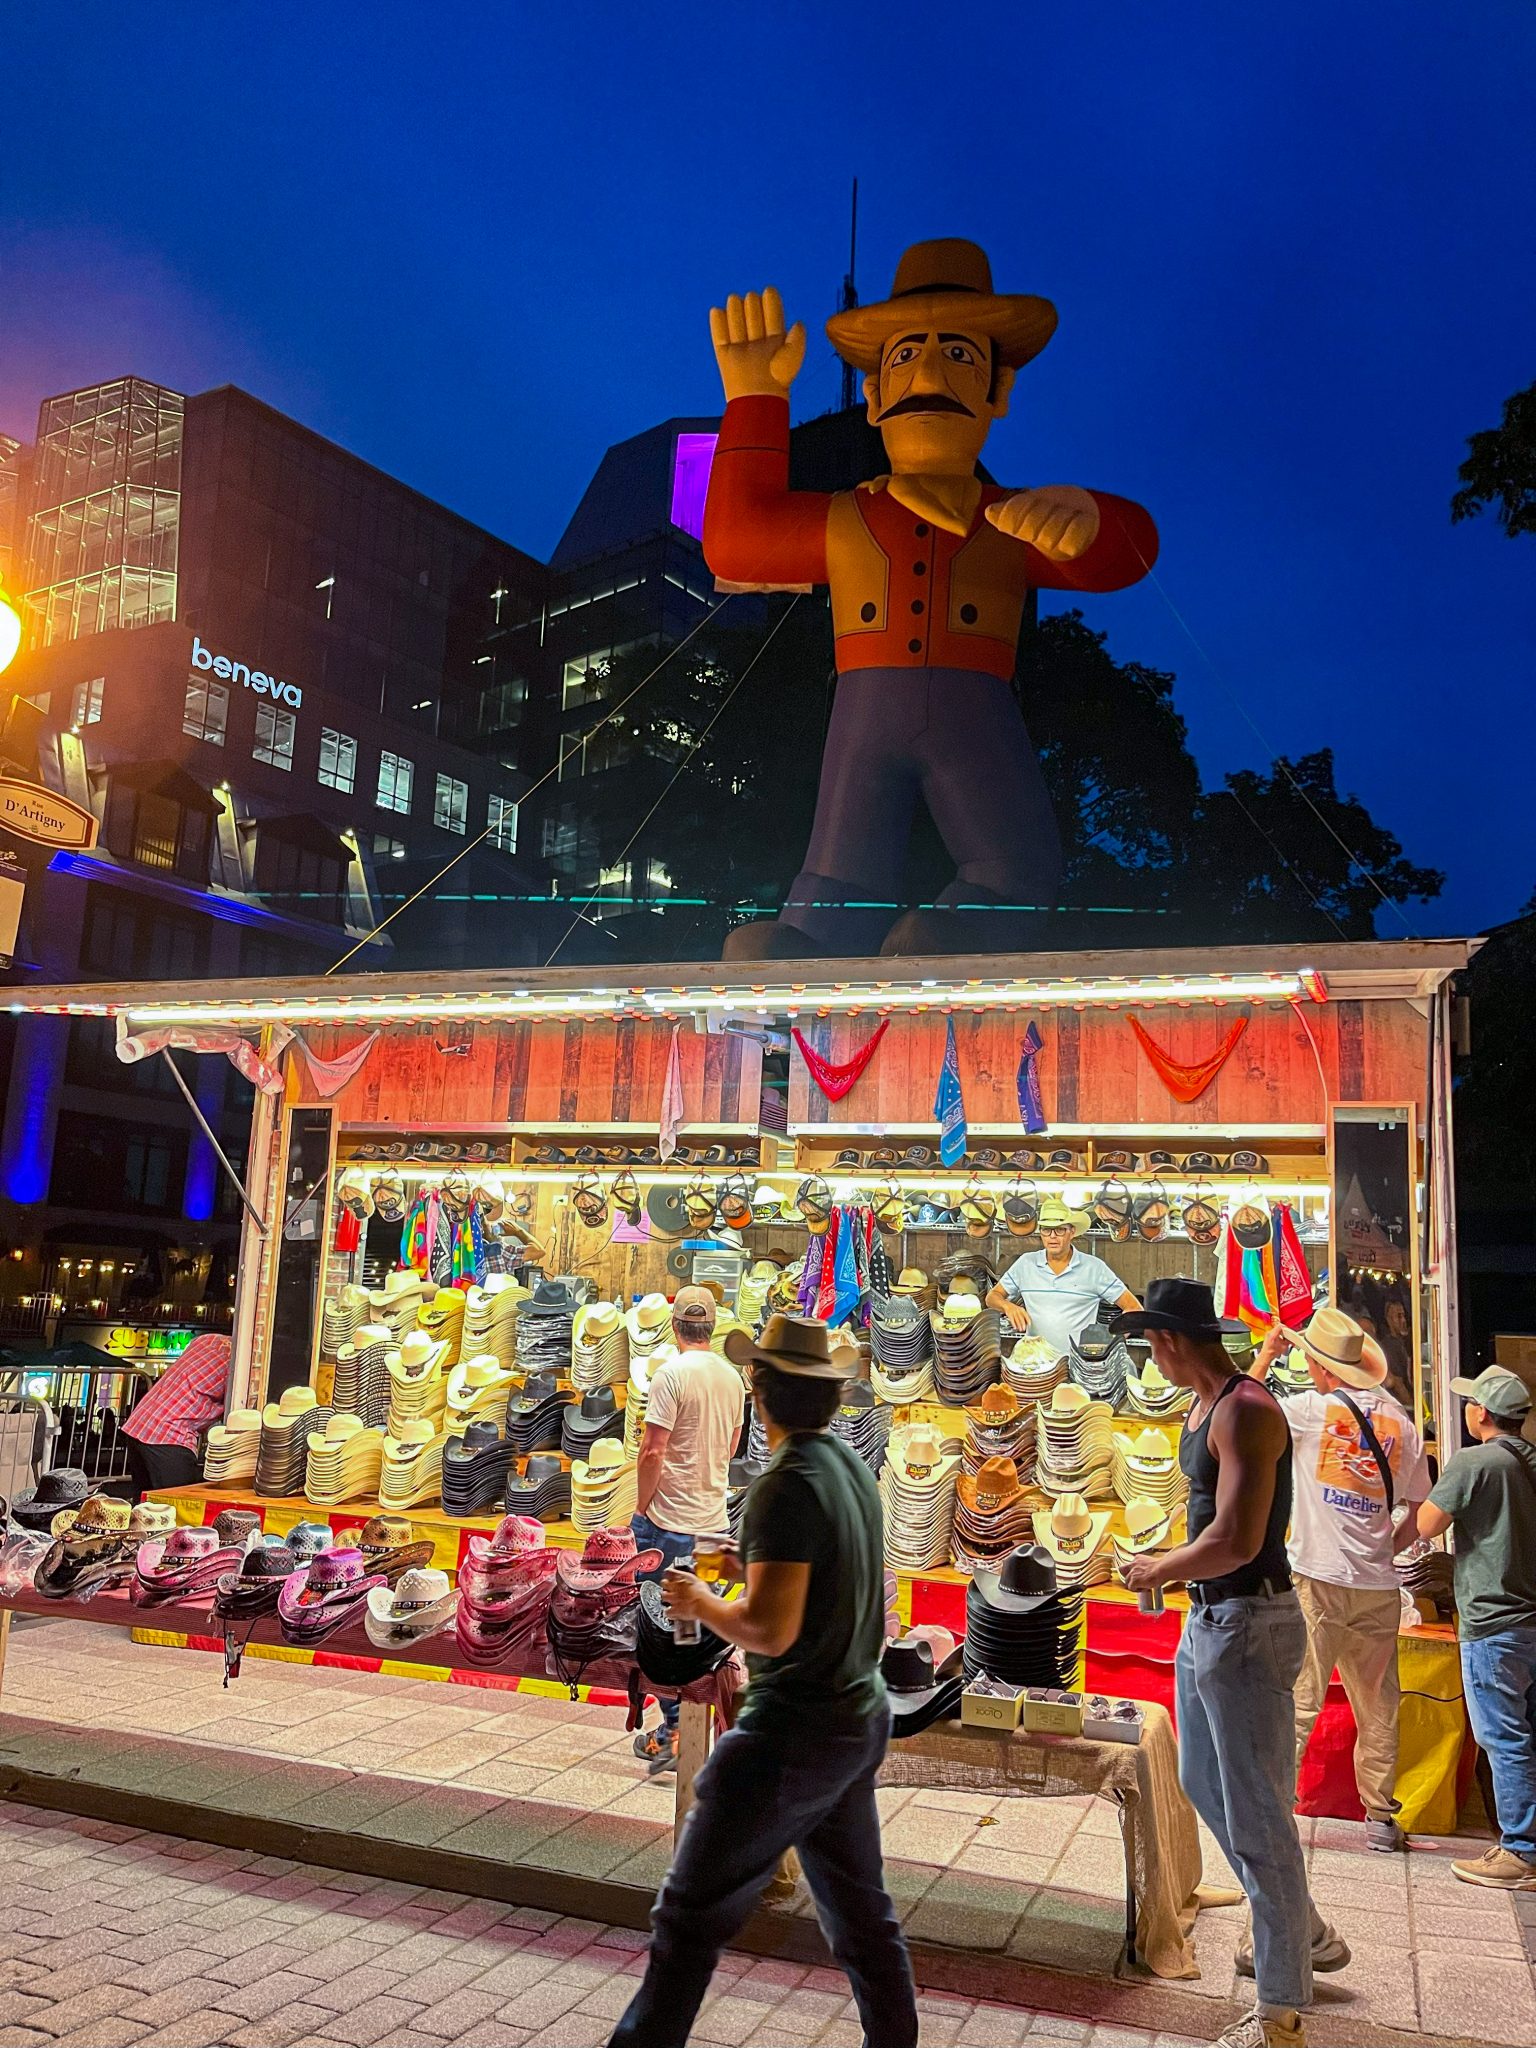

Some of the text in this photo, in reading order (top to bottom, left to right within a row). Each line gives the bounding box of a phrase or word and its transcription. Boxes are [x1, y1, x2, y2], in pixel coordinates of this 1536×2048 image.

[192, 637, 302, 708] beneva
[5, 799, 66, 832] D'Artigny
[104, 1328, 196, 1349] SUBWAY
[1323, 1488, 1382, 1513] L'atelier
